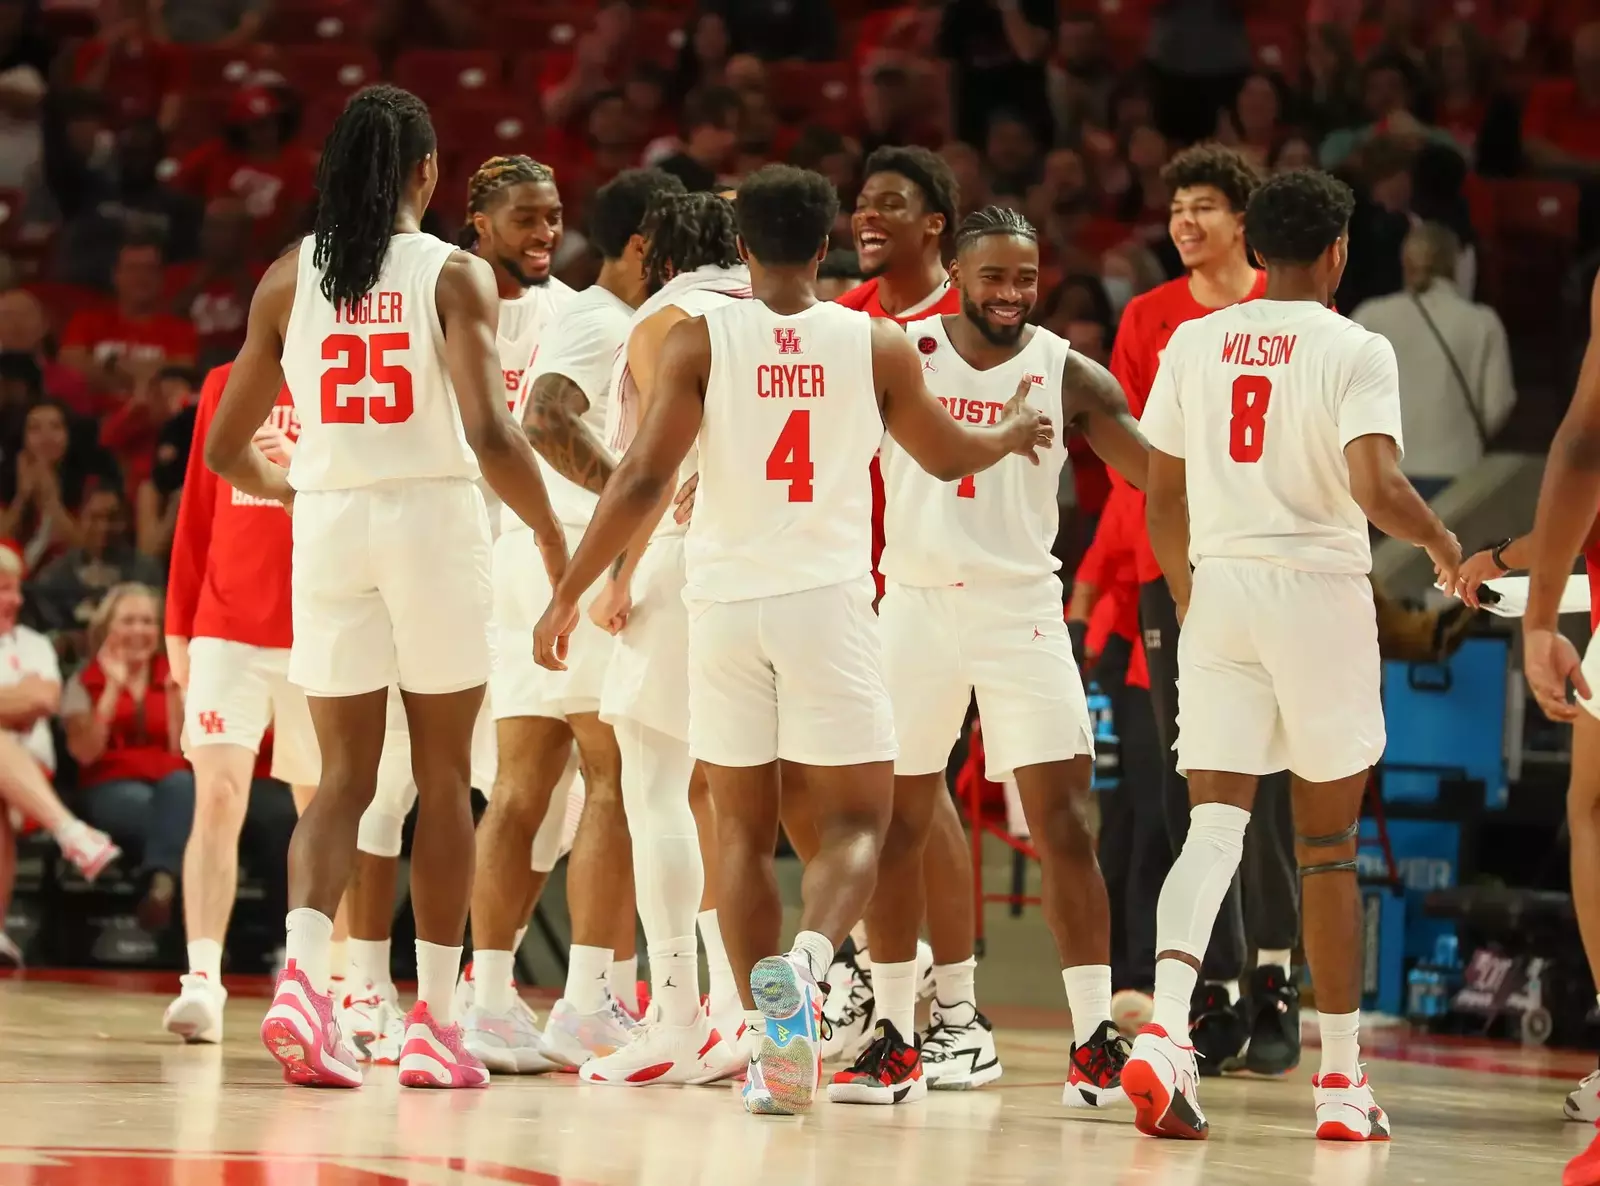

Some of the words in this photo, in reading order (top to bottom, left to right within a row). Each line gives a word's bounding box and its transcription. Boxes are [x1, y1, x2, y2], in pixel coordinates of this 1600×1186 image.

[320, 332, 414, 424] 25
[757, 364, 825, 398] CRYER
[1221, 332, 1297, 366] WILSON
[766, 409, 814, 503] 4
[1229, 374, 1272, 463] 8
